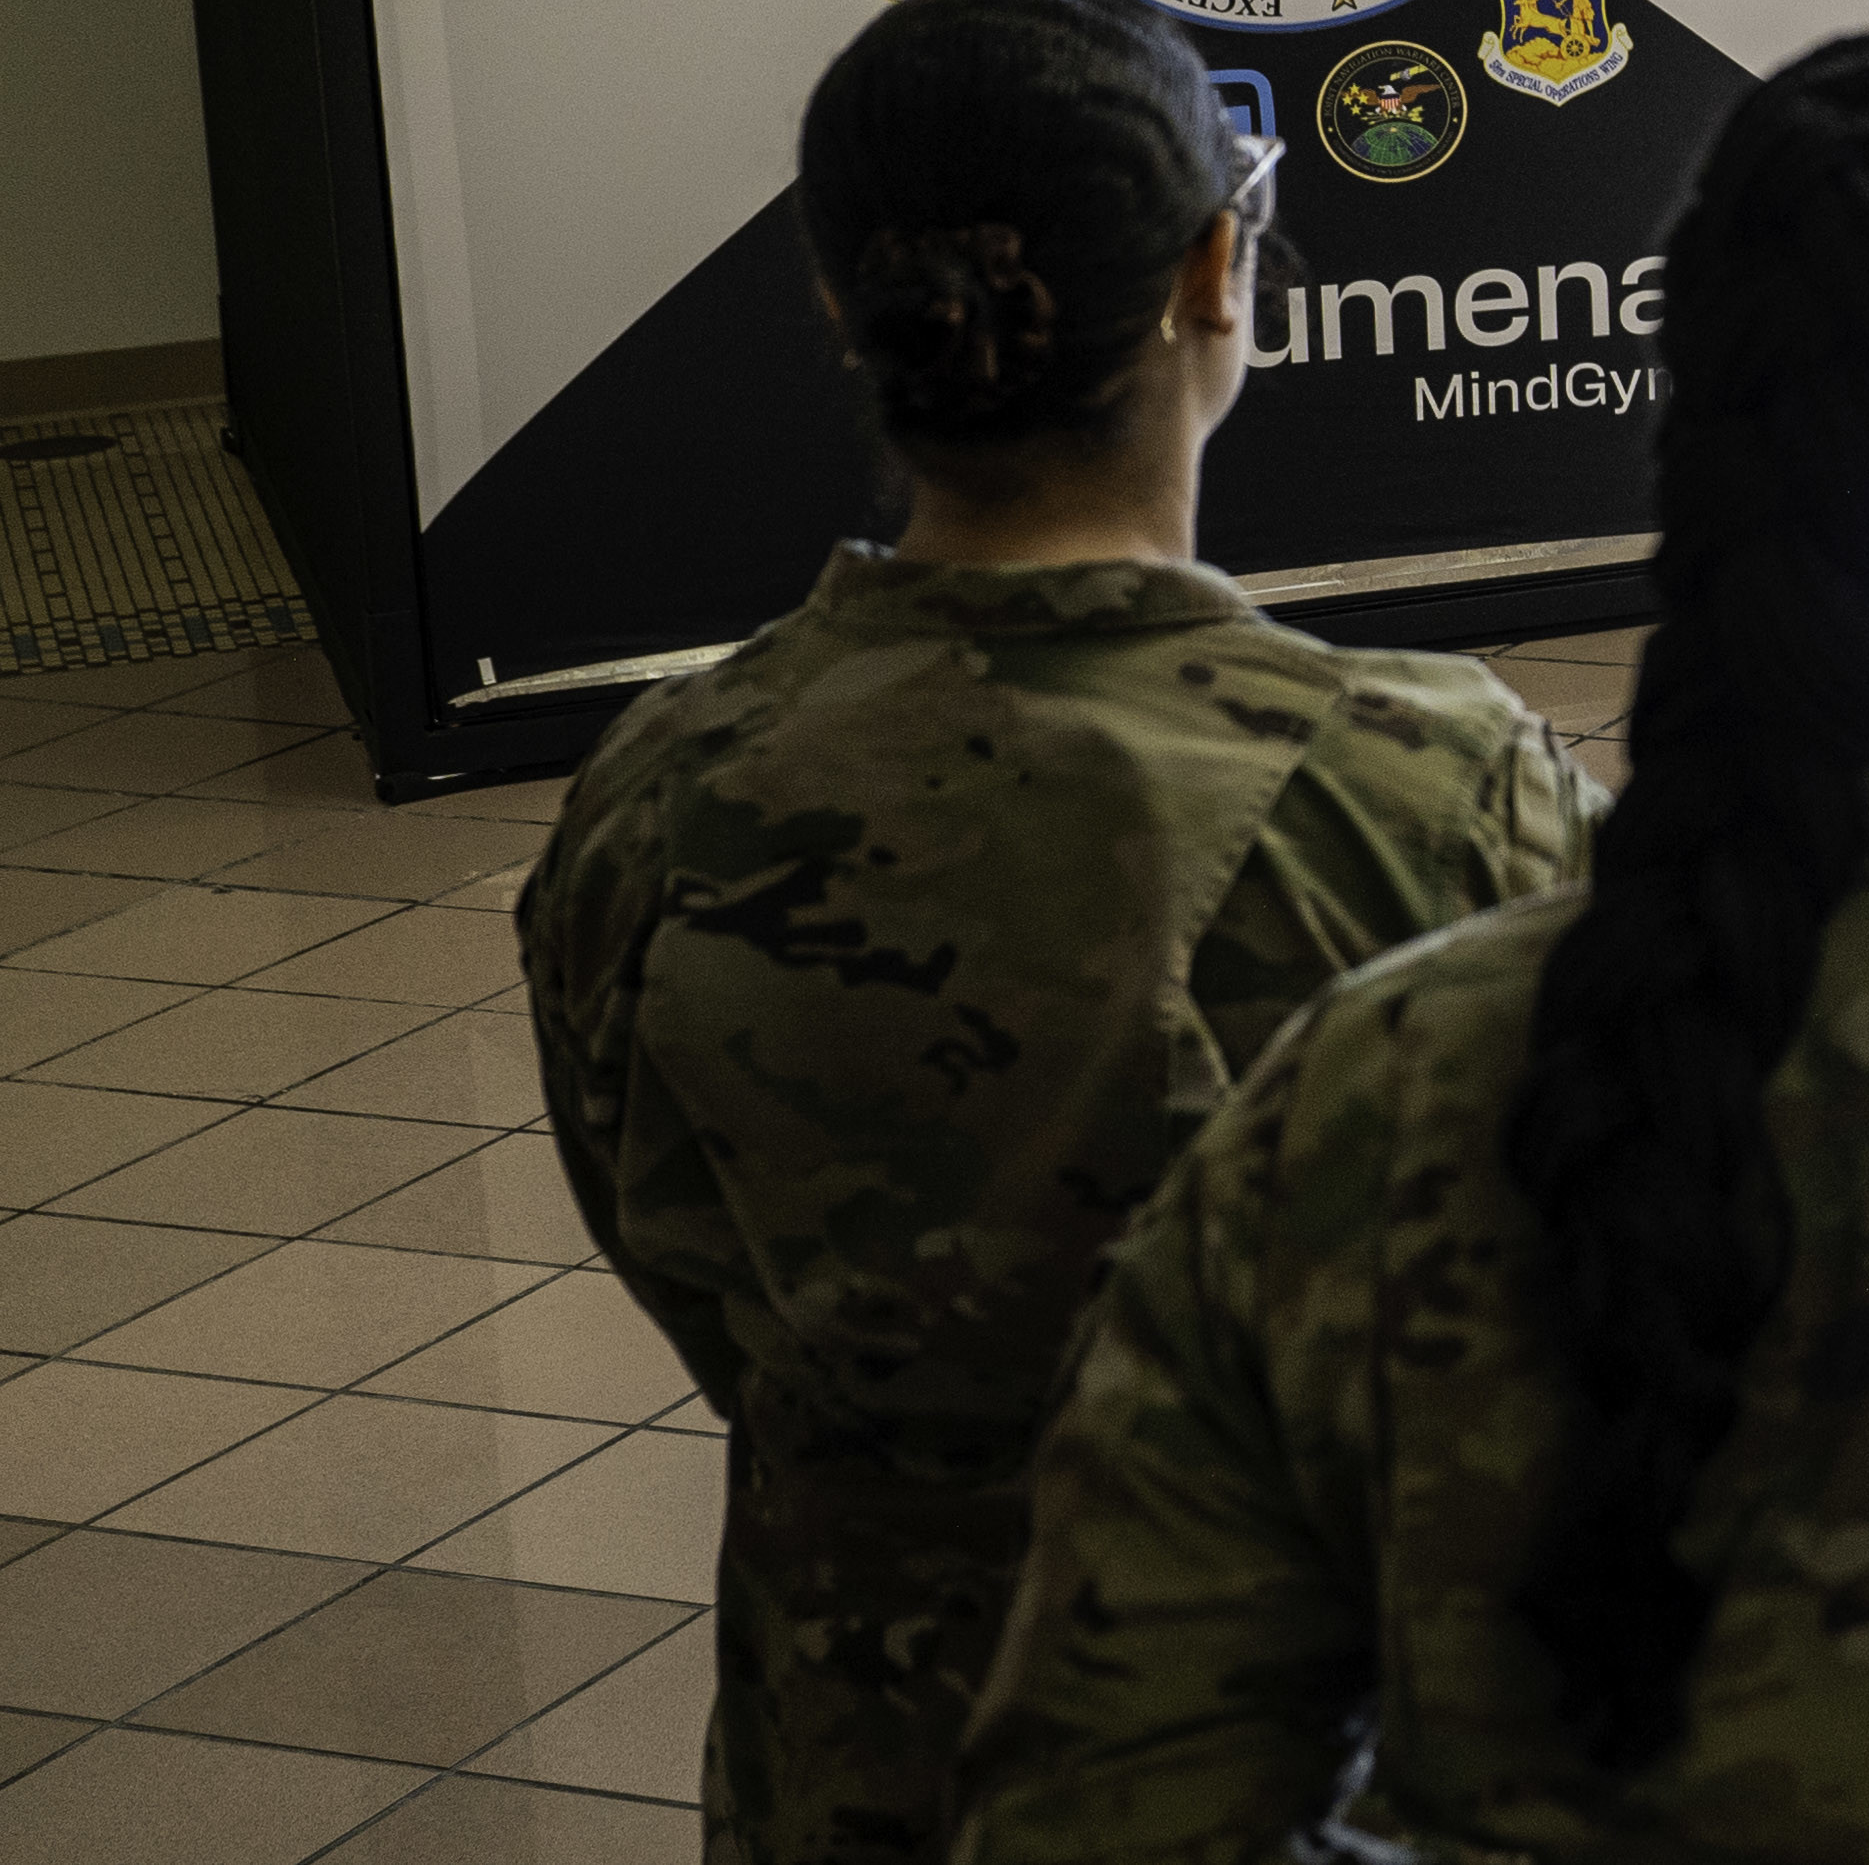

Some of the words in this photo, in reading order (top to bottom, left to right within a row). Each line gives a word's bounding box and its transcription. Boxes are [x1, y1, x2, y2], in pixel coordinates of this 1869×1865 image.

[1505, 69, 1543, 93] SPECIAL
[1544, 69, 1602, 102] OPERATIONS
[1599, 52, 1624, 79] WING
[1245, 255, 1667, 368] umena
